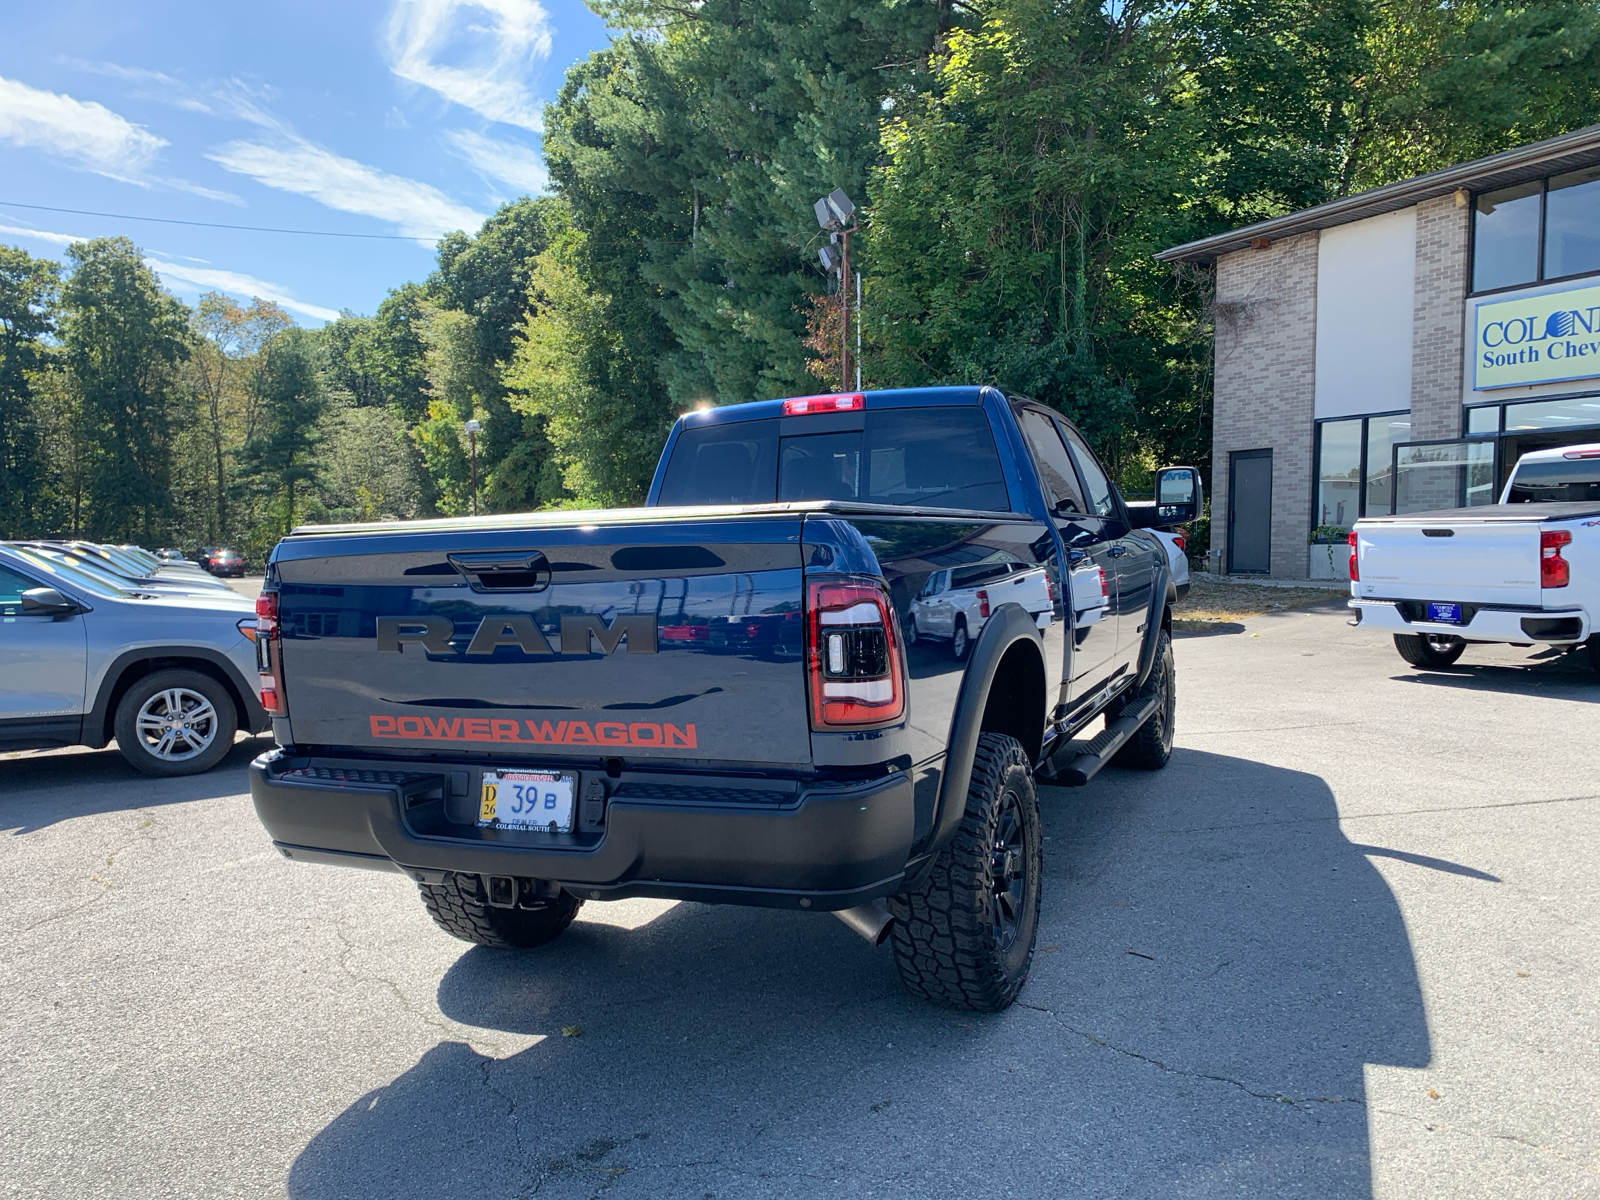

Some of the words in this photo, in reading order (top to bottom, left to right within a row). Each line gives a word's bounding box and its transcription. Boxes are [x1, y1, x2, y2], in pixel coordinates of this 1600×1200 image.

[1483, 346, 1540, 369] South
[376, 612, 659, 654] RAM
[369, 715, 520, 742] POWER
[525, 719, 697, 748] WAGON
[484, 785, 497, 801] D
[511, 784, 538, 814] 39
[544, 793, 557, 809] B
[483, 804, 496, 815] 26
[496, 823, 527, 831] COLONIAL
